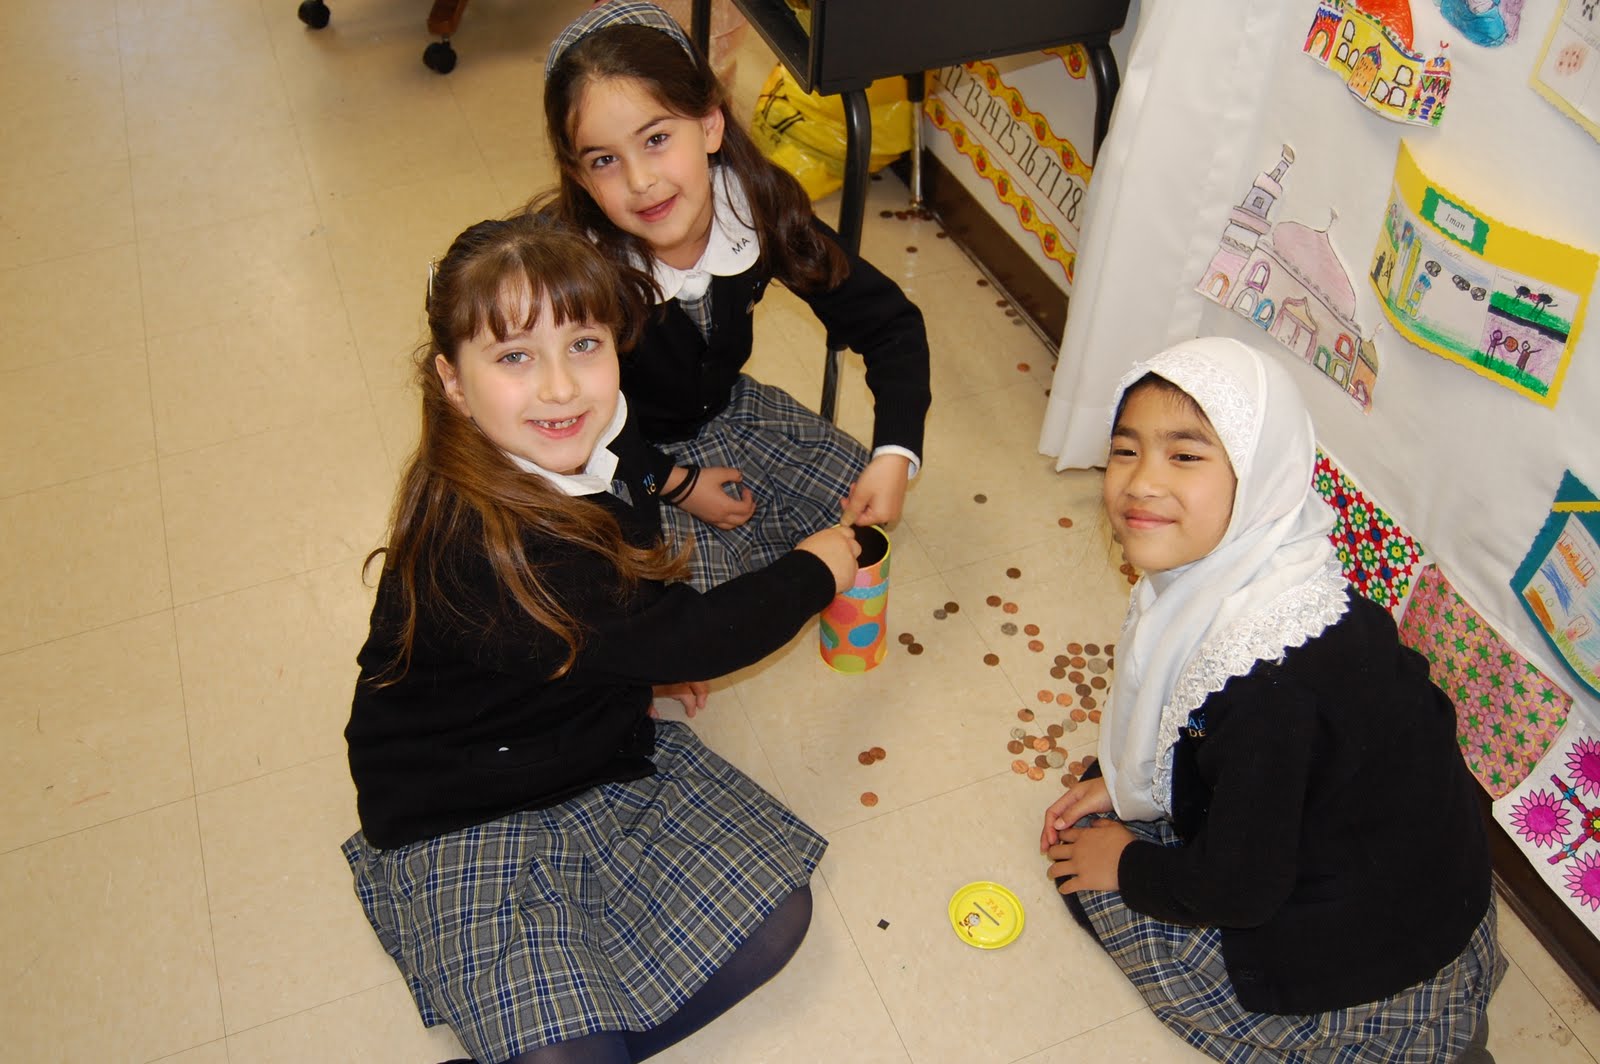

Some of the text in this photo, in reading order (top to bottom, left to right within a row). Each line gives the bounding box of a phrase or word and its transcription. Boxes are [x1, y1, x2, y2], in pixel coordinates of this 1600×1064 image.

[964, 77, 983, 118] 23
[980, 95, 1001, 135] 24
[997, 113, 1020, 155] 25
[1017, 135, 1039, 176] 26
[1036, 156, 1062, 198] 27
[1057, 177, 1082, 223] 28
[1445, 213, 1465, 231] Iman
[731, 237, 751, 255] MA
